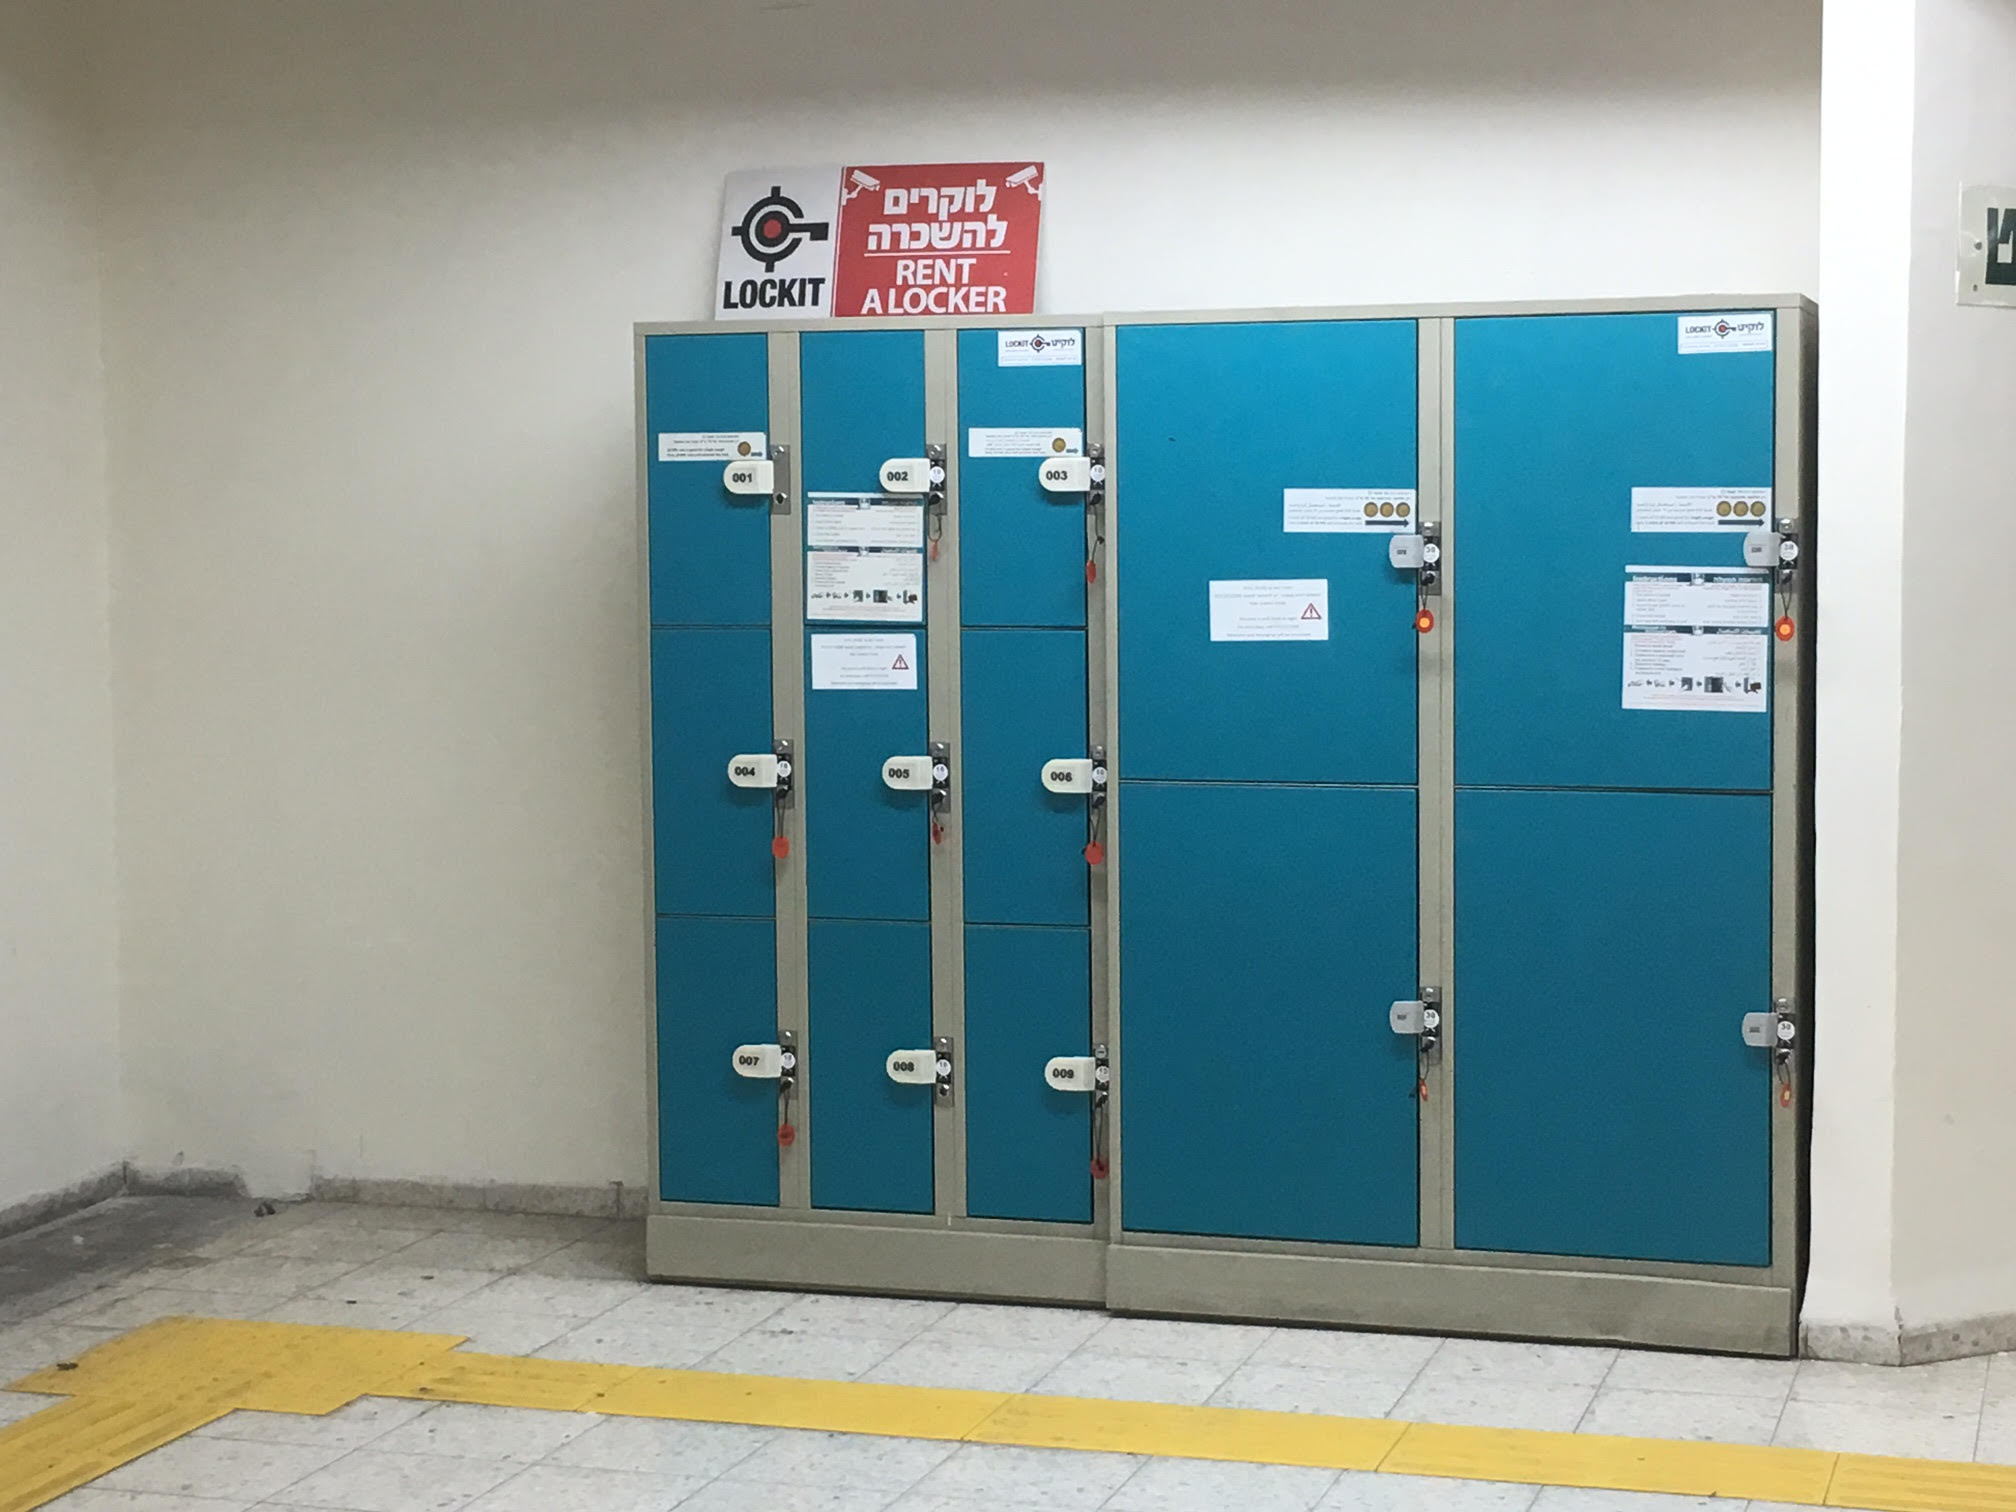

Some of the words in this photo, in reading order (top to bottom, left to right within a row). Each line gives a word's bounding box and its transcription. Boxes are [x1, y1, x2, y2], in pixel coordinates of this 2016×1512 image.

[883, 179, 997, 221] לוקרים
[867, 214, 1008, 251] להשכרה
[896, 258, 977, 286] RENT
[723, 277, 825, 309] LOCKIT
[861, 288, 883, 314] A
[887, 286, 1007, 314] LOCKER
[732, 472, 753, 483] 001
[887, 471, 909, 482] 002
[1045, 470, 1068, 481] 003
[734, 766, 755, 777] 004
[888, 768, 910, 779] 005
[1050, 772, 1072, 782] 006
[739, 1055, 760, 1066] 007
[893, 1061, 914, 1072] 008
[1052, 1068, 1074, 1079] 009
